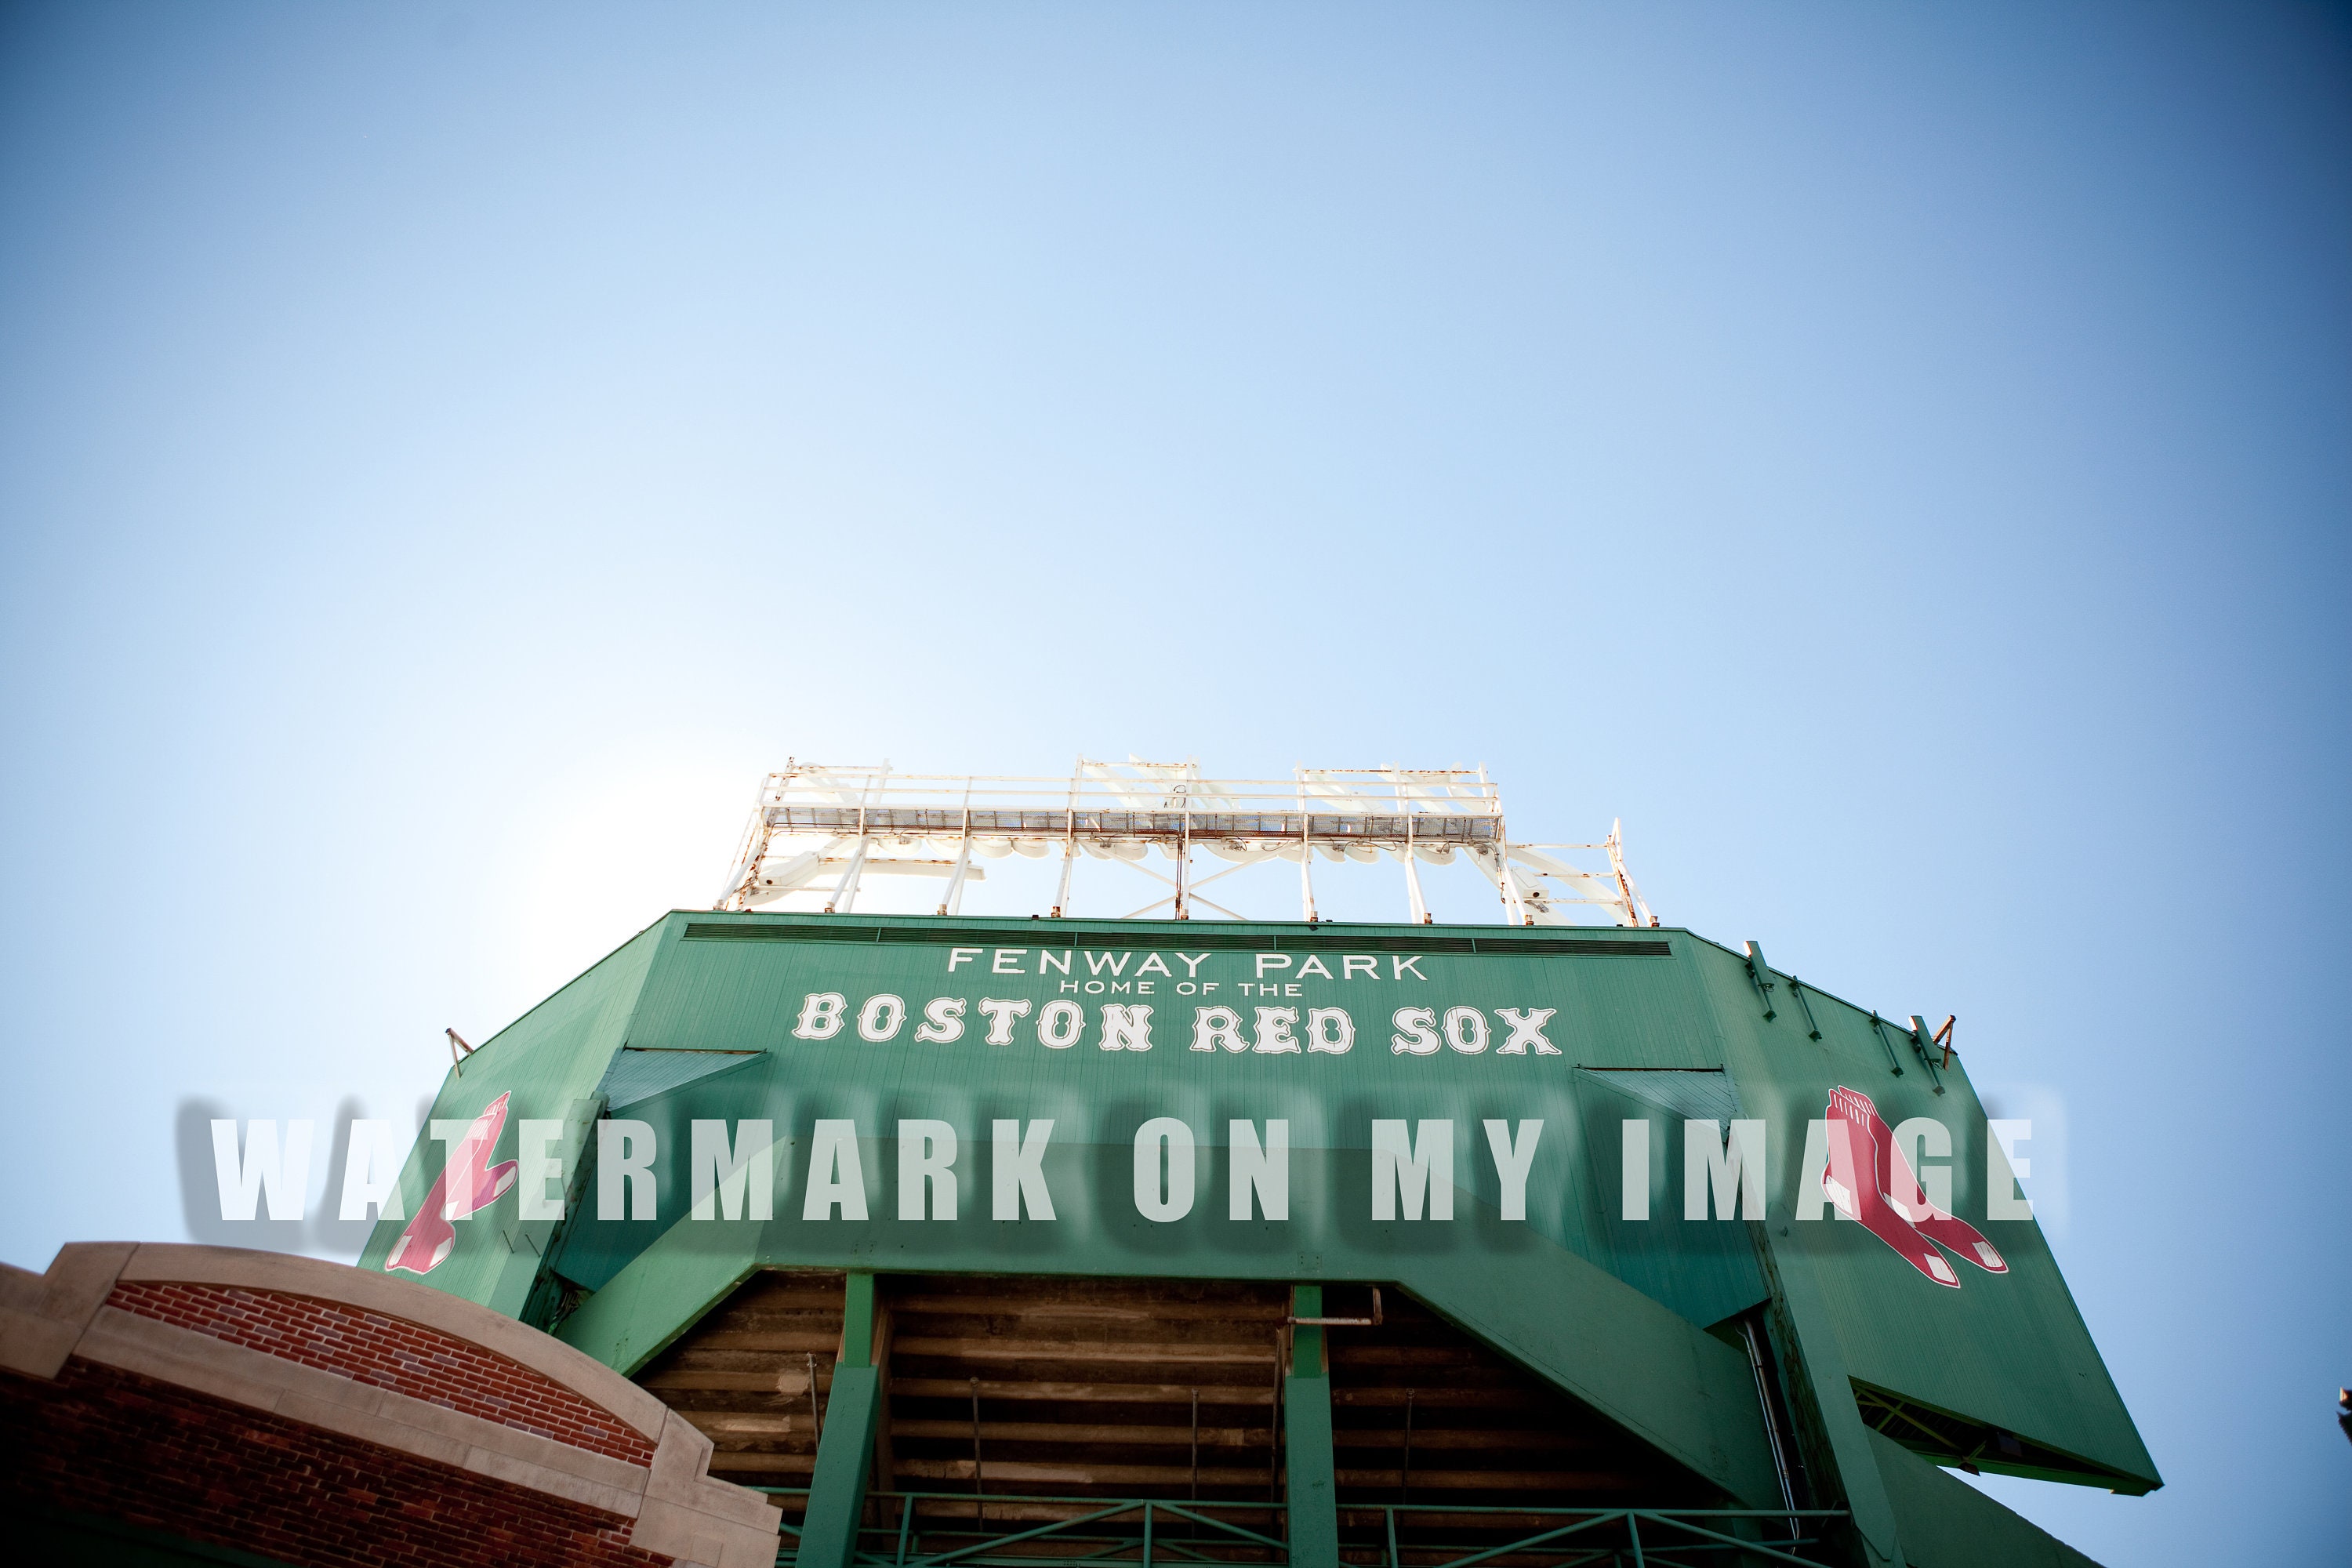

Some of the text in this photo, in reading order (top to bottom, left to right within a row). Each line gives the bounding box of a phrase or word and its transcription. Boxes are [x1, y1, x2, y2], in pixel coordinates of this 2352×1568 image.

[949, 947, 1428, 981] FENWAY PARK
[1060, 980, 1303, 996] HOME OF THE
[792, 992, 1563, 1056] BOSTON RED SOX
